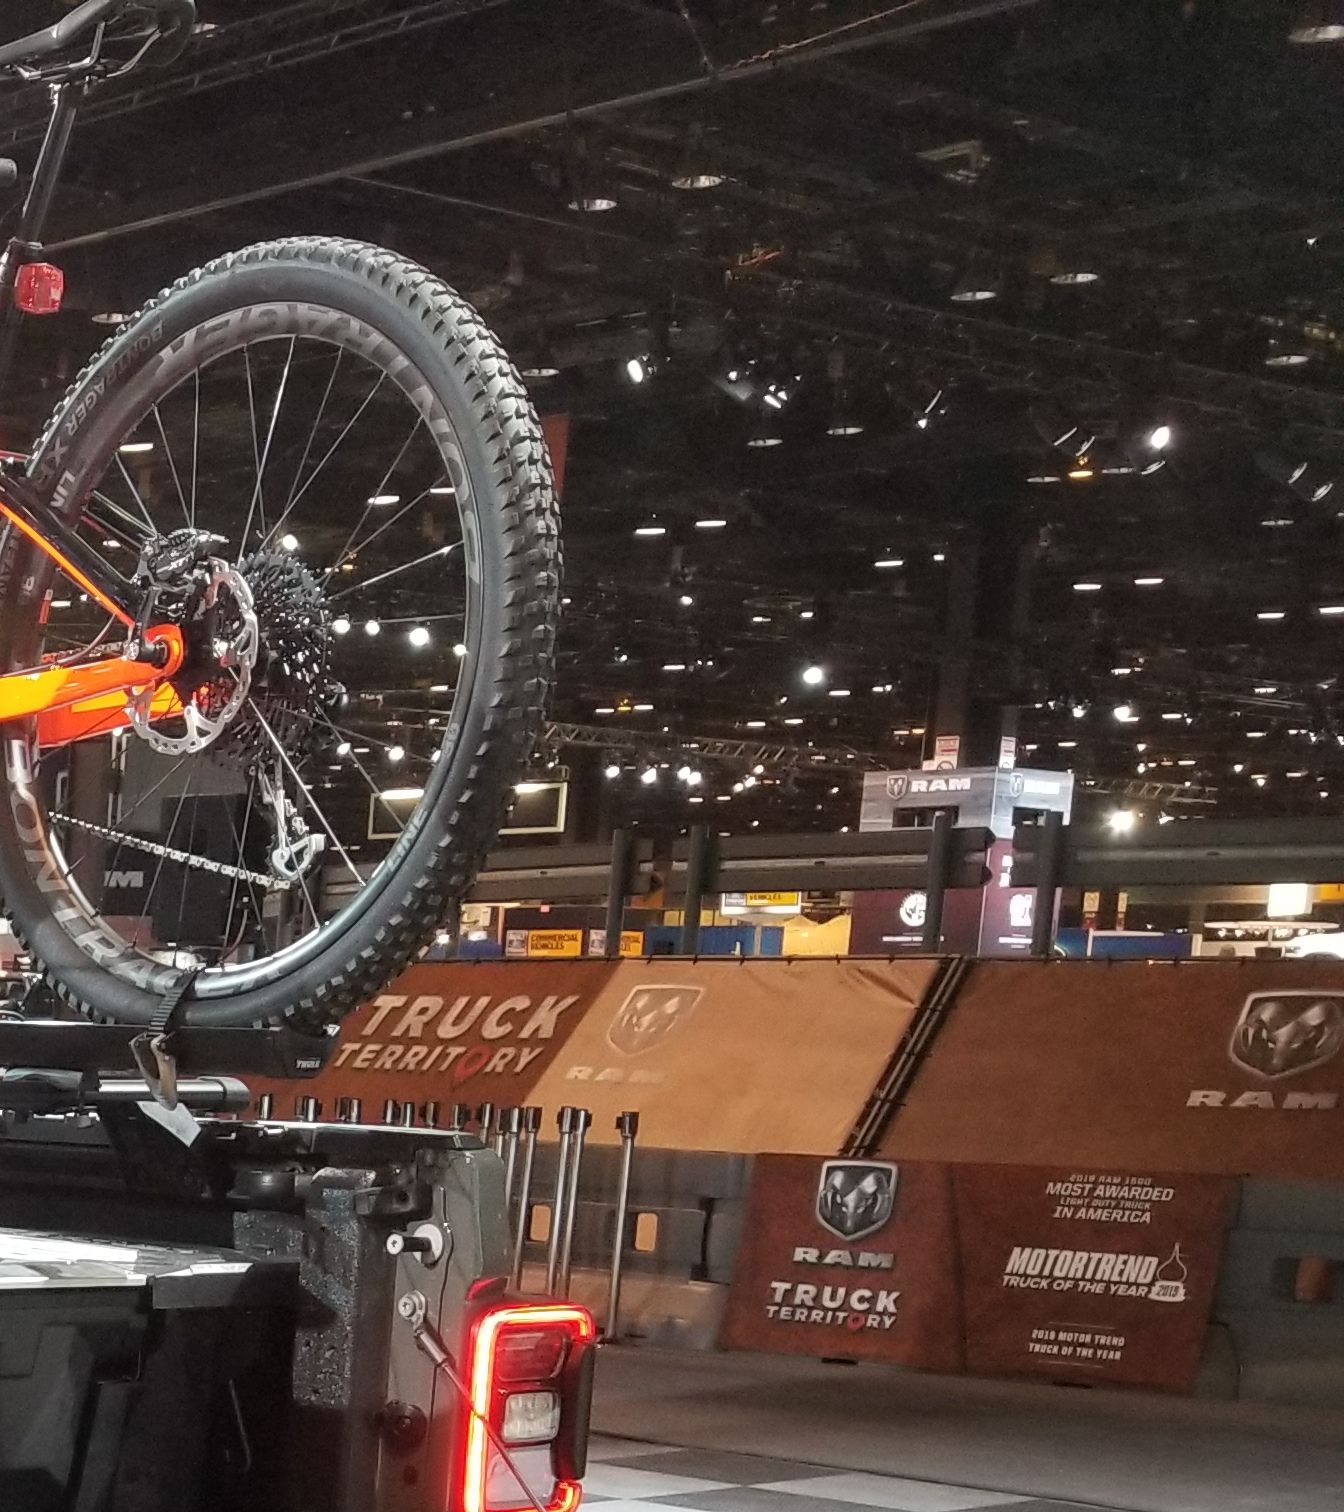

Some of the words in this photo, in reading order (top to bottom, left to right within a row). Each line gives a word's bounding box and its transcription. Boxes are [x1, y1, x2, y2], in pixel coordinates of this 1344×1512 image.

[64, 318, 163, 437] BONTRAGER
[911, 777, 971, 793] RAM
[362, 995, 579, 1040] TRUCK
[333, 1043, 544, 1083] TERRITORY
[565, 1066, 665, 1082] RAM
[1186, 1089, 1340, 1110] RAM
[1046, 1182, 1093, 1197] MOST
[1093, 1184, 1175, 1201] AWARDED
[1060, 1197, 1089, 1206] LIGHT
[1091, 1199, 1117, 1208] DUTY
[1119, 1200, 1152, 1209] TRUCK
[1053, 1206, 1074, 1218] IN
[1075, 1208, 1152, 1224] AMERICA
[792, 1247, 894, 1269] RAM
[1005, 1246, 1159, 1284] MOTORTREND
[771, 1280, 901, 1313] TRUCK
[1002, 1275, 1053, 1290] TRUCK
[1053, 1279, 1075, 1291] OF
[1077, 1281, 1107, 1294] THE
[1109, 1283, 1149, 1297] YEAR
[766, 1305, 897, 1331] TERRITORY
[1057, 1330, 1092, 1344] MOTOR
[1094, 1334, 1125, 1347] TREND
[1028, 1342, 1059, 1355] TRUCK
[1061, 1345, 1074, 1356] OF
[1076, 1347, 1094, 1358] THE
[1096, 1348, 1122, 1360] YEAR
